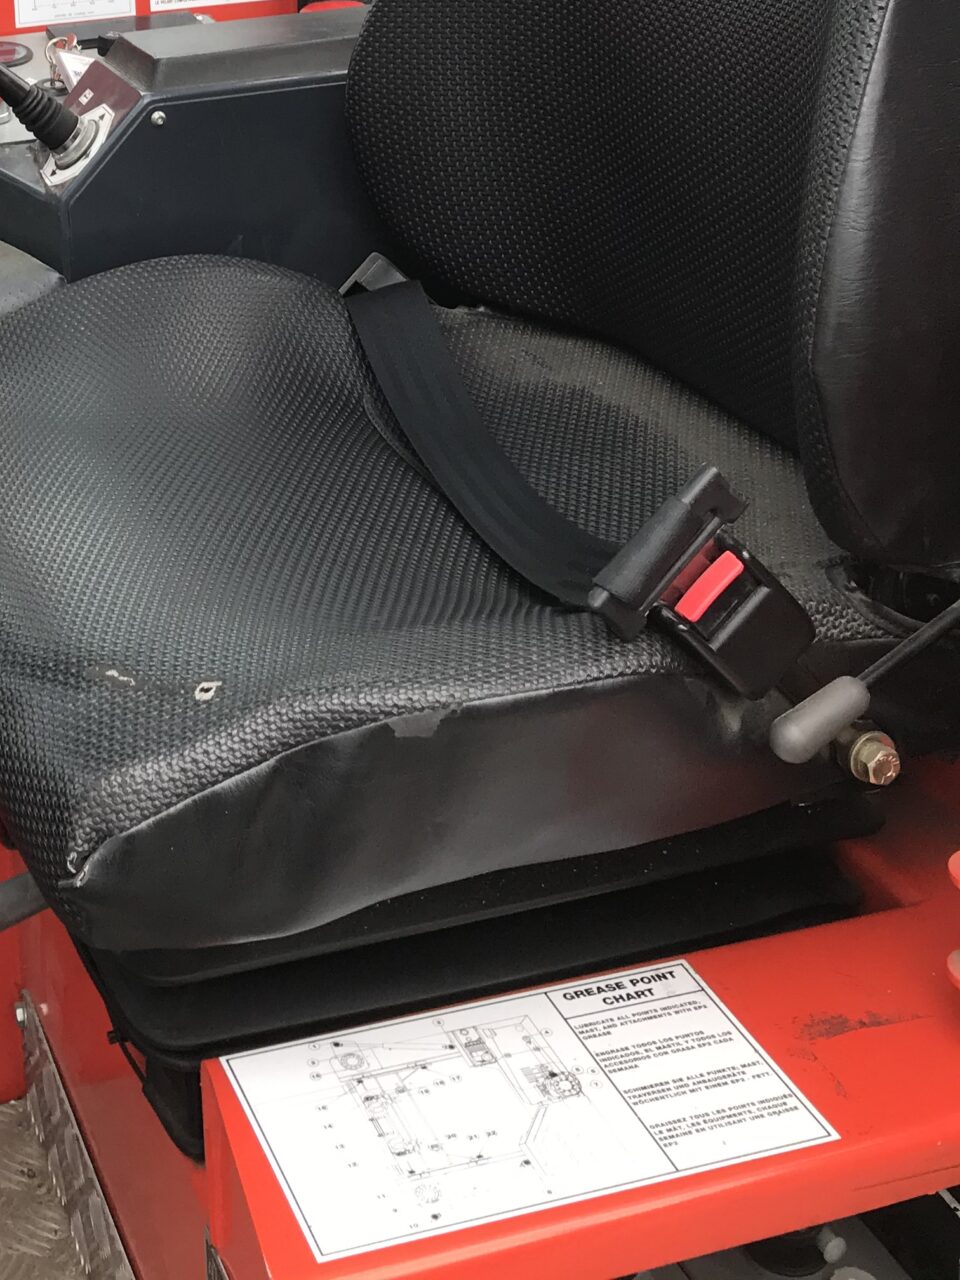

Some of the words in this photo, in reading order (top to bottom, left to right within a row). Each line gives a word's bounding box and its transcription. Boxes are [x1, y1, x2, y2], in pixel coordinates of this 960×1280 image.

[561, 979, 628, 1002] GREASE
[627, 969, 679, 987] POINT
[600, 986, 658, 1006] CHART
[630, 1007, 659, 1017] POINTS
[600, 1022, 618, 1030] AND
[581, 1030, 612, 1040] GREASE
